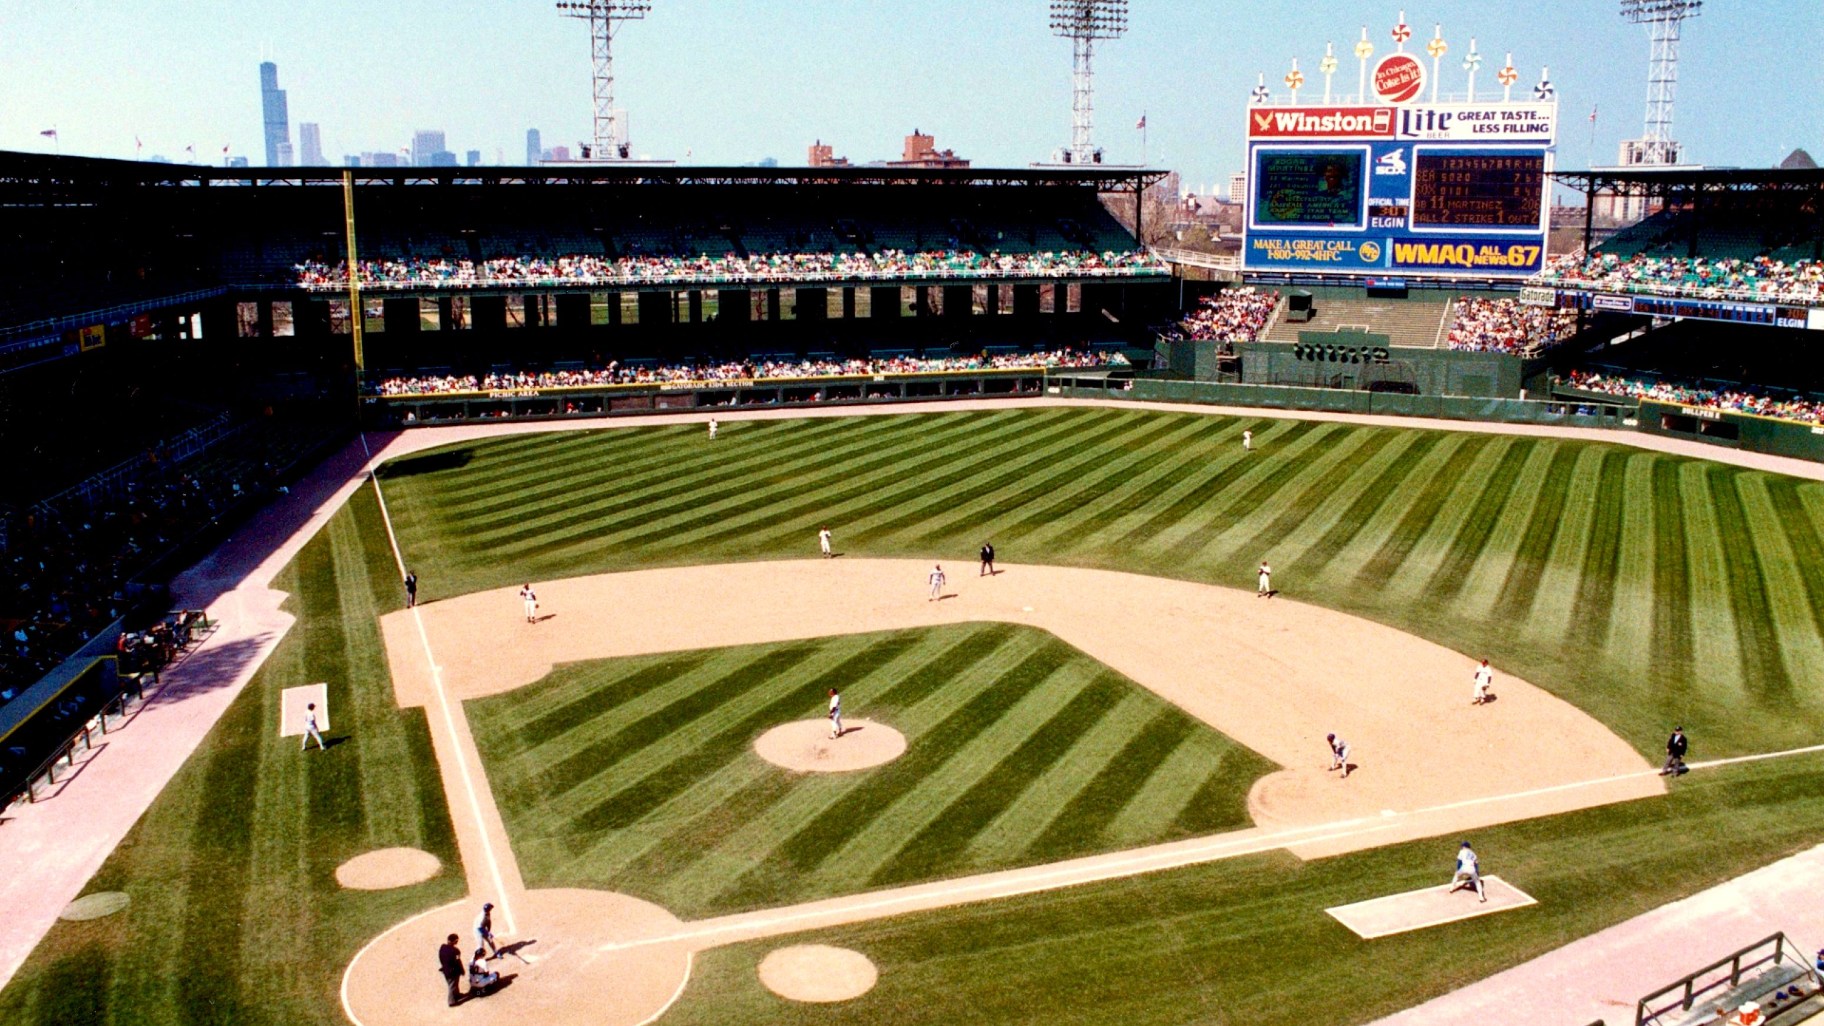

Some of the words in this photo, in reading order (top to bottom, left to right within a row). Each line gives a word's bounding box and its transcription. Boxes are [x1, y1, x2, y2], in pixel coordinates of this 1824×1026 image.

[1377, 77, 1400, 91] Coke
[1457, 111, 1496, 120] GREAT
[1274, 112, 1372, 132] Winston
[1402, 109, 1452, 137] Lite
[1472, 124, 1500, 134] LESS
[1503, 123, 1550, 133] FILLING
[1443, 159, 1446, 167] 1
[1450, 159, 1455, 167] 2
[1458, 159, 1463, 167] 3
[1473, 160, 1479, 168] 5
[1489, 160, 1495, 168] 7
[1368, 198, 1392, 206] OFFICIAL
[1395, 198, 1410, 206] TIME
[1430, 196, 1445, 208] 11
[1448, 200, 1502, 210] MARTINEZ
[1414, 214, 1439, 222] BALL
[1442, 209, 1449, 222] 2
[1455, 214, 1494, 223] STRIKE
[1497, 211, 1504, 224] 1
[1508, 214, 1530, 224] OUT
[1531, 211, 1538, 224] 2
[1372, 218, 1404, 228] ELGIN
[1254, 239, 1282, 249] MAKE
[1283, 240, 1291, 249] A
[1292, 240, 1325, 250] GREAT
[1327, 240, 1356, 251] CALL.
[1394, 243, 1475, 268] WMAQ
[1480, 246, 1501, 256] ALL
[1508, 245, 1540, 266] 67
[1474, 255, 1508, 265] NEWS
[1521, 288, 1554, 302] Gatorade
[1778, 318, 1804, 328] ELGIN
[1682, 407, 1714, 418] BULLPEN
